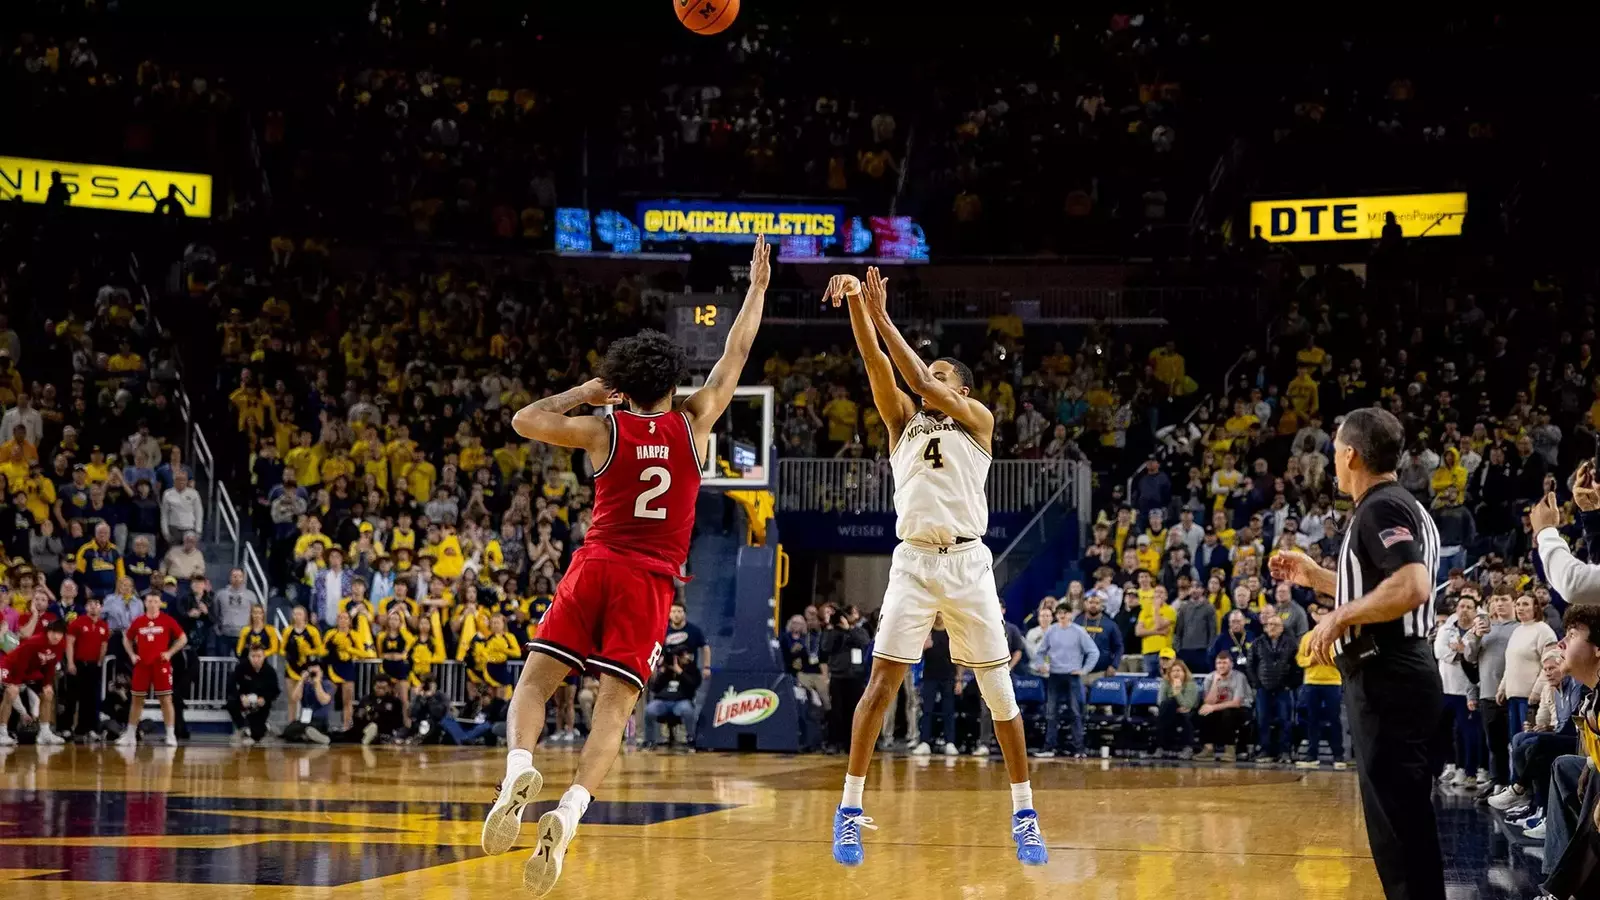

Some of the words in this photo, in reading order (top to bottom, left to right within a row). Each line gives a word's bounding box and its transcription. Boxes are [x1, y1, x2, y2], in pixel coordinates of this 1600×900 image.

[645, 210, 836, 235] @UMICHATHLETICS
[1271, 204, 1357, 236] DTE
[636, 445, 670, 460] HARPER
[923, 437, 944, 469] 4
[634, 466, 672, 520] 2
[838, 525, 884, 537] WEISER
[938, 547, 948, 555] M
[714, 696, 772, 724] LIBMAN
